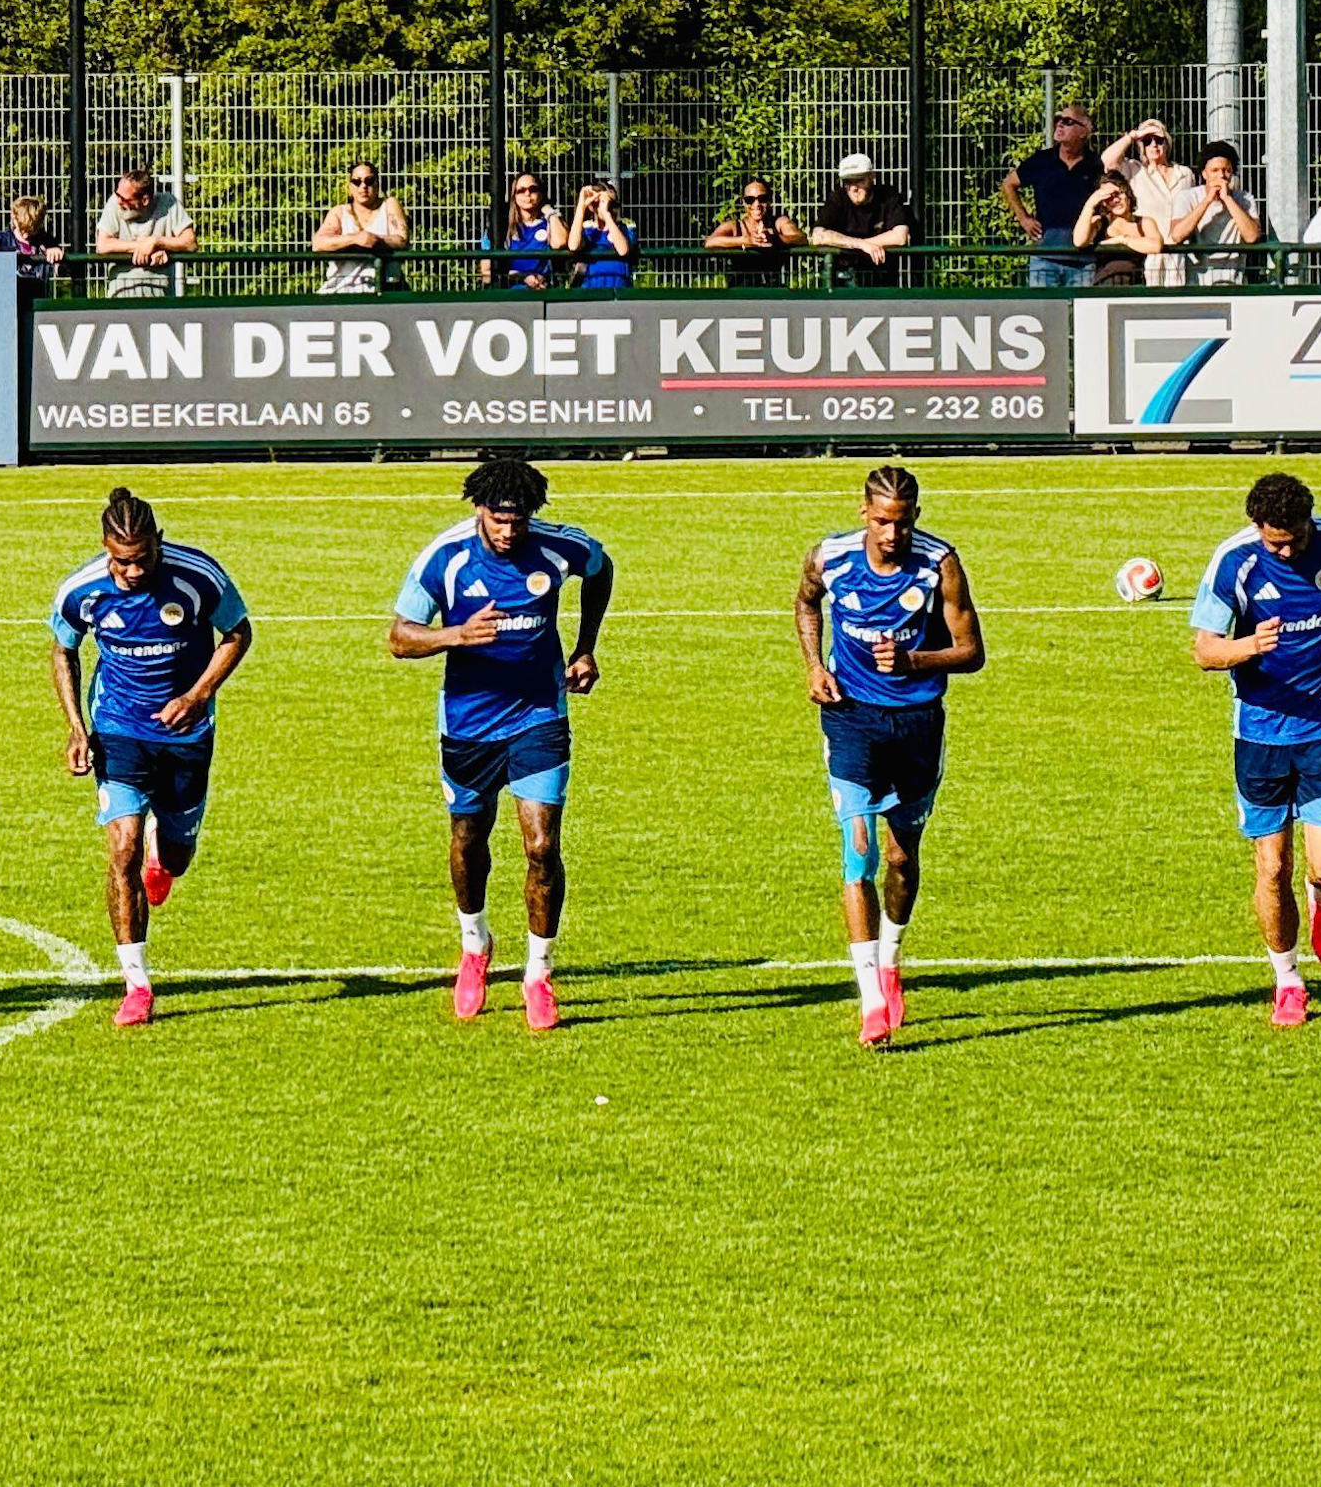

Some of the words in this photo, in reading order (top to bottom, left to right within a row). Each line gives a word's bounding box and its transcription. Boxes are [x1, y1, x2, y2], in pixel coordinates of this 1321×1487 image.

[37, 321, 203, 380] VAN
[233, 319, 395, 378] DER
[415, 317, 632, 376] VOET
[659, 314, 1046, 373] KEUKENS
[38, 402, 324, 428] WASBEEKERLAAN
[334, 401, 370, 425] 65
[442, 398, 653, 423] SASSENHEIM
[744, 397, 810, 421] TEL.
[822, 396, 895, 421] 0252
[925, 395, 979, 420] 232
[991, 394, 1044, 419] 806
